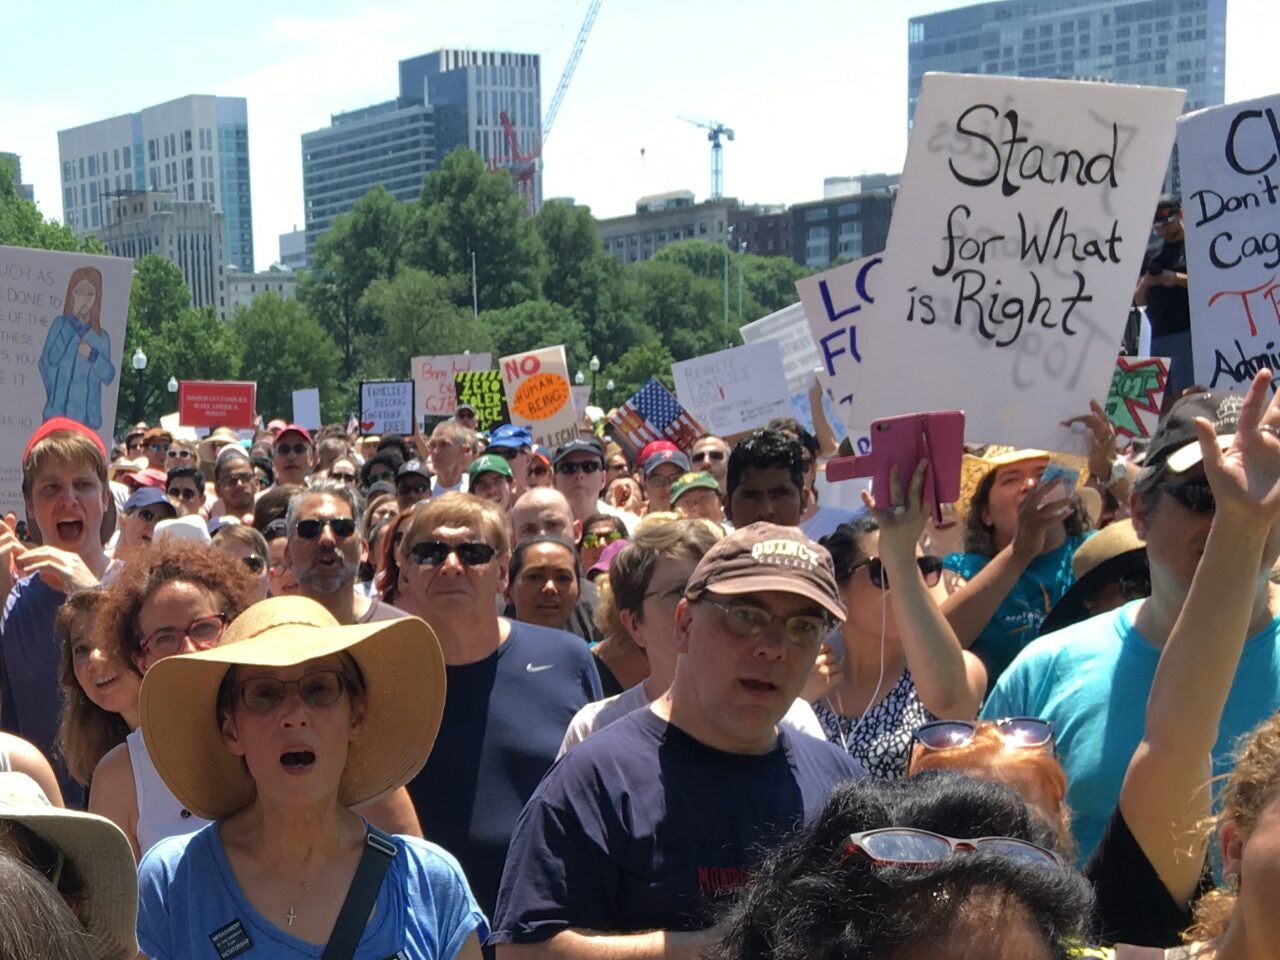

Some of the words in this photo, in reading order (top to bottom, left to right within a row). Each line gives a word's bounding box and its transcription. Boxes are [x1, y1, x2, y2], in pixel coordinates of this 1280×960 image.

[949, 104, 1118, 196] Stand
[1190, 175, 1280, 227] Don't
[932, 205, 1005, 276] for
[1019, 207, 1122, 264] What
[36, 269, 55, 286] AS
[7, 287, 44, 306] DONE
[49, 295, 62, 309] TO
[907, 286, 936, 325] is
[952, 269, 1092, 346] Right
[8, 310, 24, 323] OF
[27, 313, 49, 328] THE
[0, 330, 33, 345] THESE
[504, 355, 541, 384] NO
[463, 380, 500, 394] ZERO
[516, 375, 553, 404] HUMAN
[528, 389, 560, 414] BEING
[751, 539, 819, 567] QUINCY
[758, 555, 813, 571] COLLEGE
